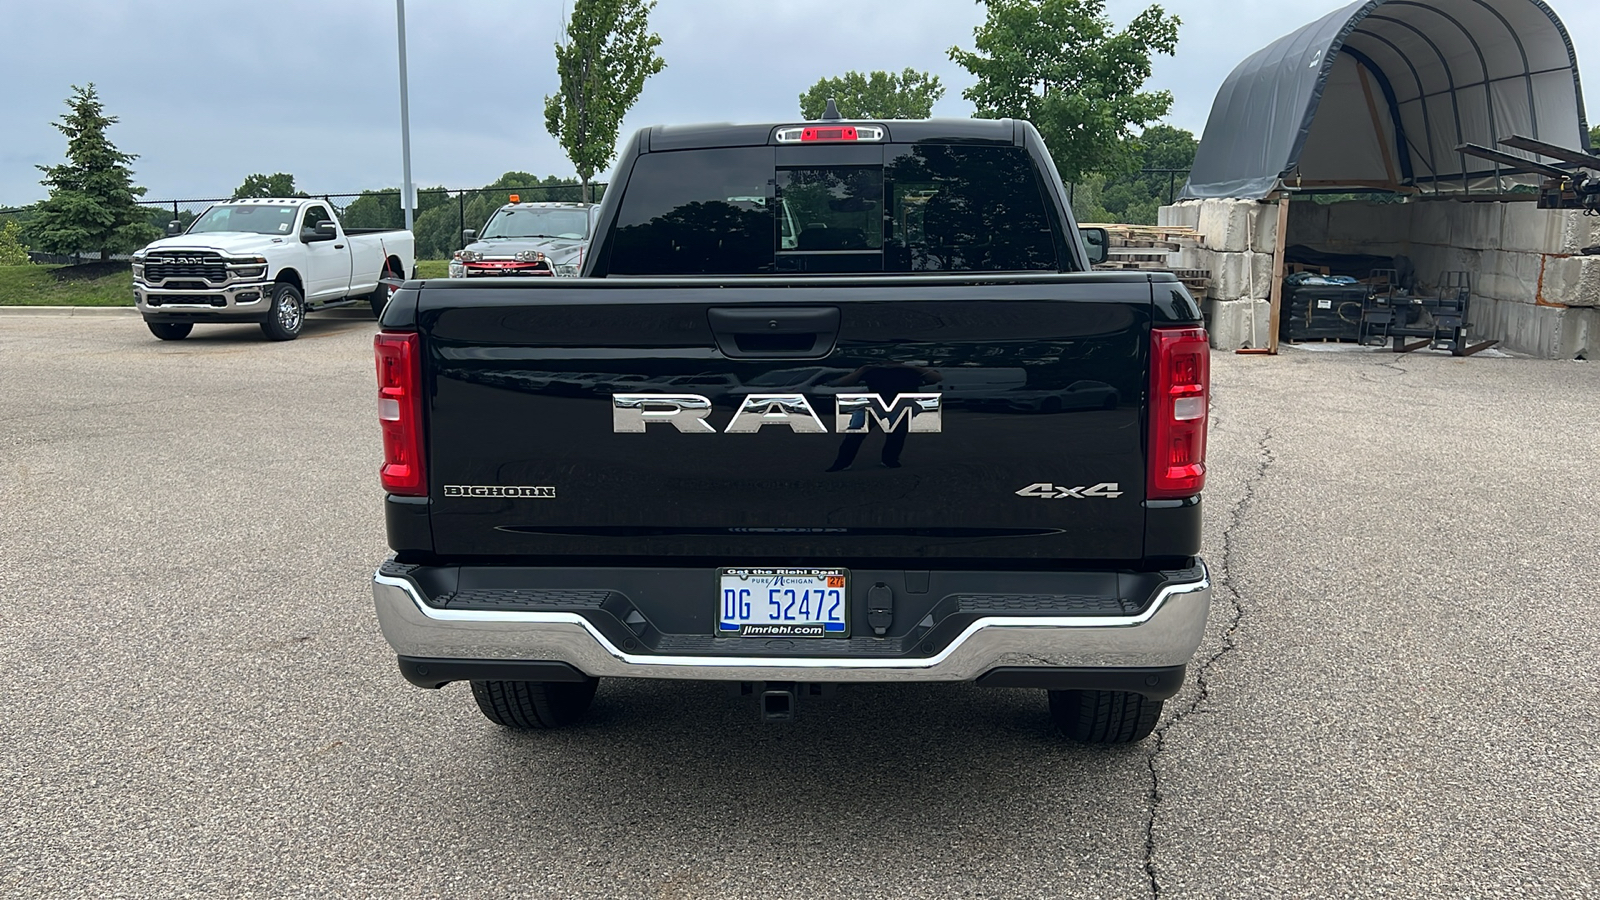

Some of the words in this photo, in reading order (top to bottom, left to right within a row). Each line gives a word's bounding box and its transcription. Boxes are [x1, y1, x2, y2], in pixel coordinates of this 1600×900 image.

[162, 257, 203, 265] RAM
[612, 392, 943, 434] RAM
[444, 485, 556, 498] BIGHORN
[1014, 482, 1124, 499] 4x4
[766, 575, 813, 588] MICHIGAN
[724, 589, 751, 620] DG
[768, 589, 840, 621] 52472
[743, 626, 822, 635] jimriehl.com
